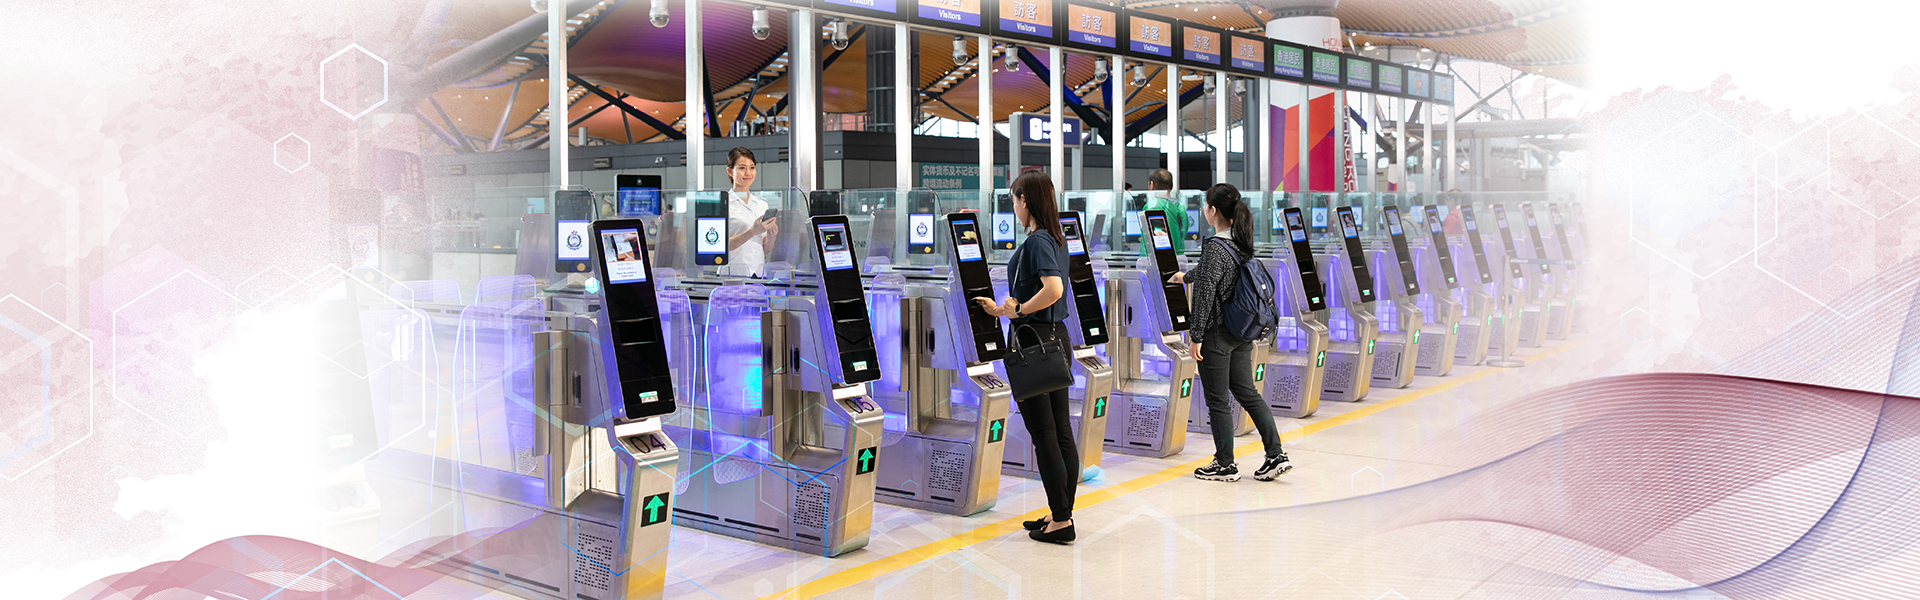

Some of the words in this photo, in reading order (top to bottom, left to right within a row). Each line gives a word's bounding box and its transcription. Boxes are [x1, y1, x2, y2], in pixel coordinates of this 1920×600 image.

[938, 9, 961, 21] Visitors
[1014, 0, 1037, 20] 訪客
[1016, 22, 1036, 33] Visitors
[1082, 13, 1102, 32] 訪客
[1083, 33, 1102, 44] Visitors
[1141, 24, 1159, 41] 訪客
[1143, 43, 1159, 53] Visitors
[1195, 52, 1210, 61] Visitors
[977, 374, 1004, 389] 06
[844, 396, 874, 414] 05
[630, 433, 667, 454] 04
